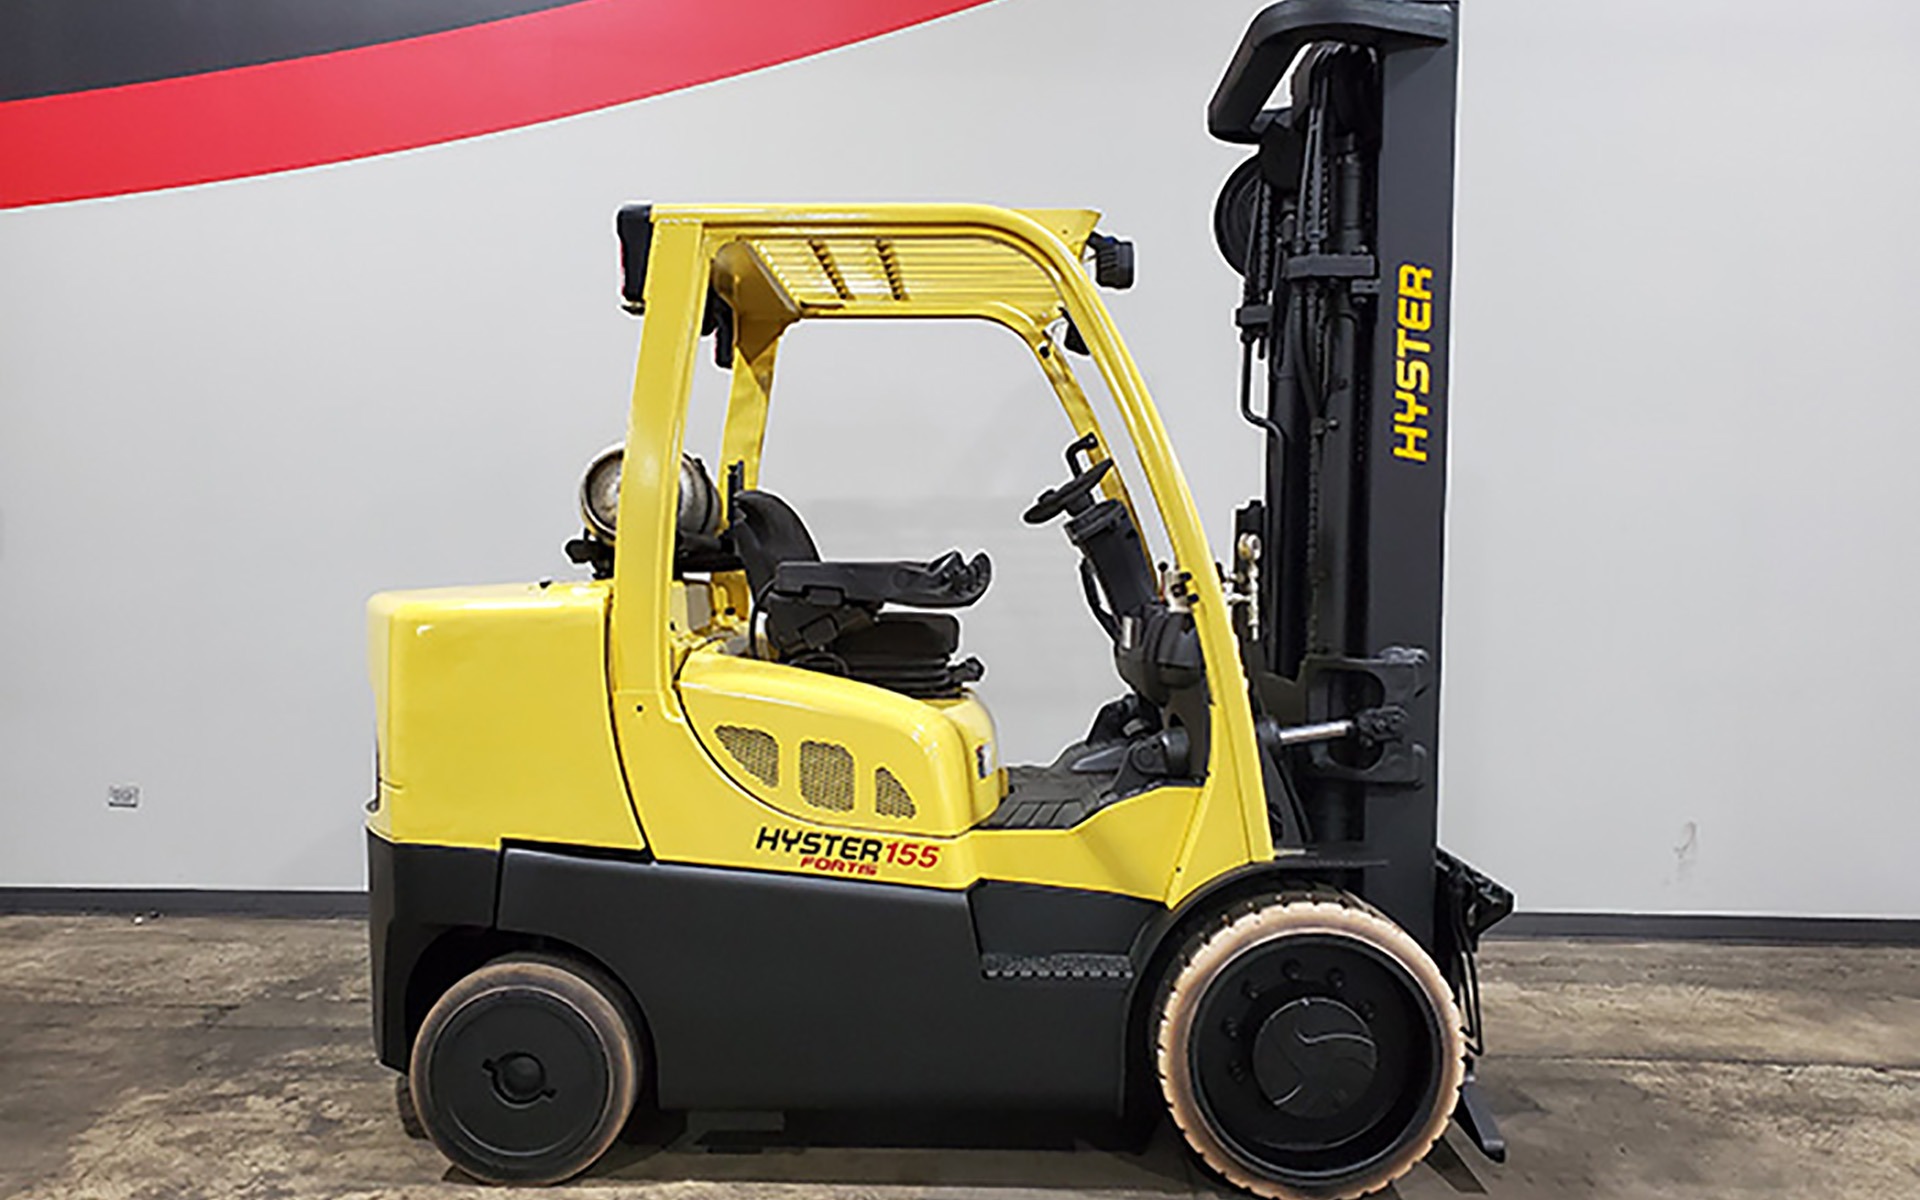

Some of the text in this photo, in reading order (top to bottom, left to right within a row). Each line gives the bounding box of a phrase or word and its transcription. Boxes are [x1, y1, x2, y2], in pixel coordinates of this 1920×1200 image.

[1393, 264, 1433, 461] HYSTER
[756, 827, 940, 868] HYSTER 155
[800, 856, 877, 876] FORTIS
